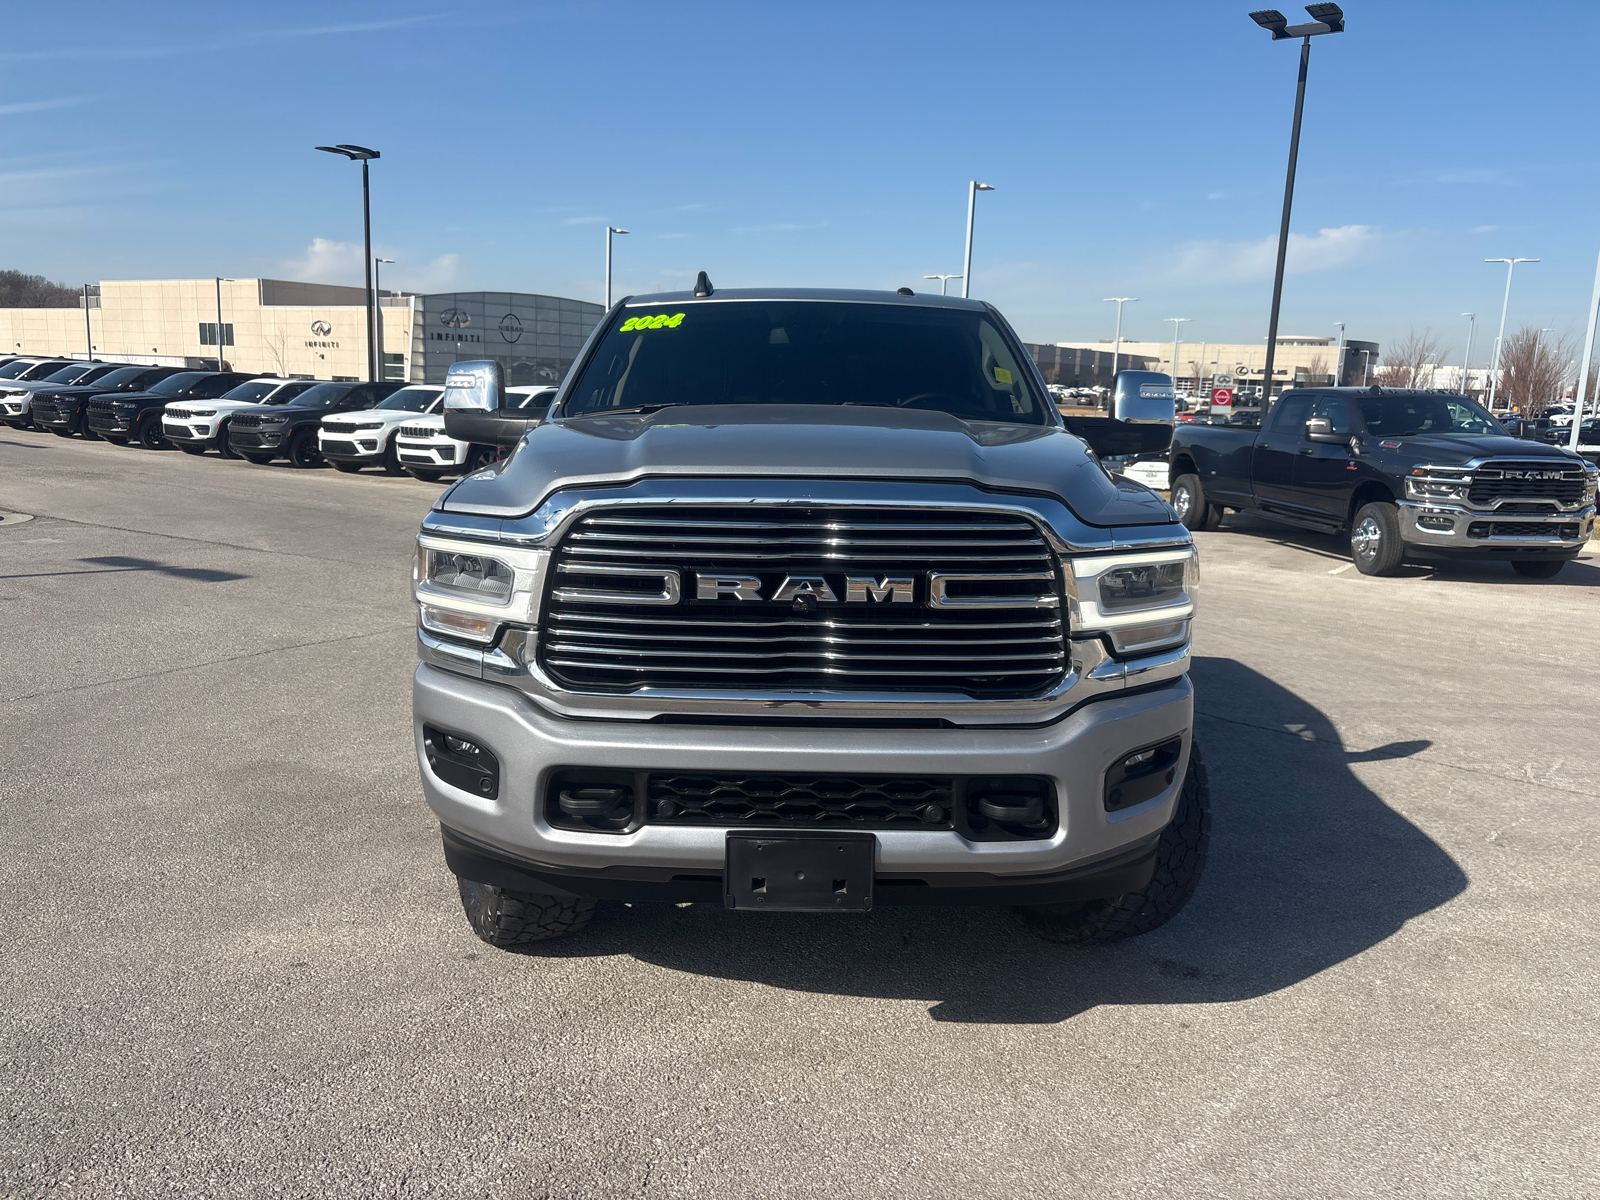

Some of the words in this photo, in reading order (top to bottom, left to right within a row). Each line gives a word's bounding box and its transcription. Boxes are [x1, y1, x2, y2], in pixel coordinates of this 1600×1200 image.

[619, 313, 686, 332] 2024
[430, 332, 480, 343] INFINITI
[304, 340, 340, 349] INFINITI
[1250, 368, 1288, 376] LEUS
[1505, 470, 1561, 480] RAM
[696, 573, 915, 603] RAM
